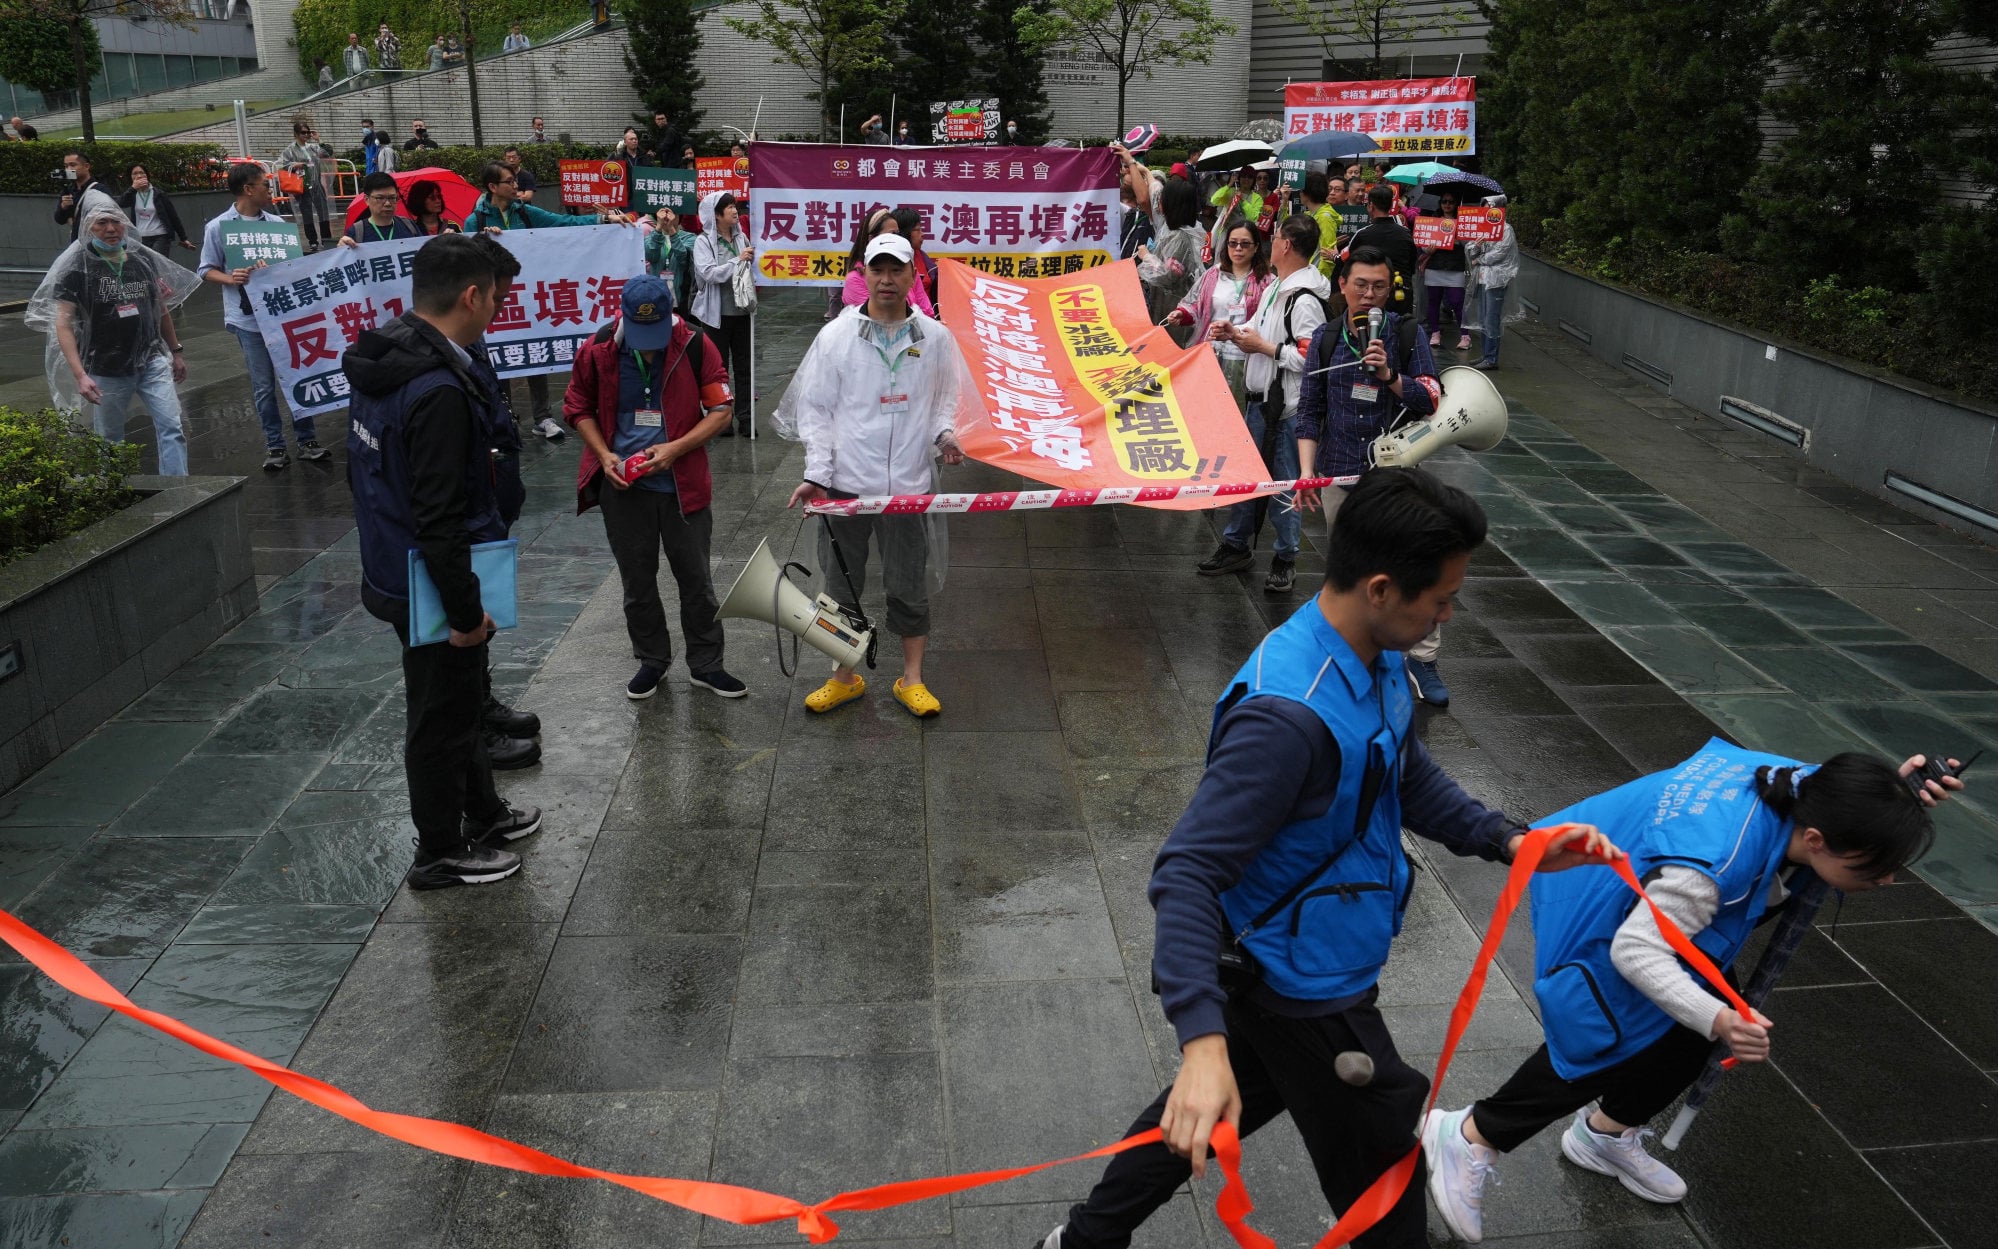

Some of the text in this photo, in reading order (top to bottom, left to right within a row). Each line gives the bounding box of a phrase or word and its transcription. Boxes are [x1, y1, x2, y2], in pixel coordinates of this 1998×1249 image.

[1082, 63, 1100, 71] LENG
[1102, 64, 1120, 72] PUBLI
[1289, 108, 1469, 135] 反對將軍澳再填海
[1376, 138, 1466, 152] 要垃圾處理廠!!
[857, 158, 1050, 180] 都會駅業主委員會
[563, 172, 599, 182] 反對興建
[564, 183, 591, 192] 水泥廠
[634, 178, 695, 193] 反對將軍澳
[647, 194, 684, 207] 再填海
[226, 232, 299, 247] 反對將軍澳
[242, 247, 287, 260] 再填海
[937, 254, 1106, 279] 垃圾處理廠!!
[262, 250, 419, 317] 維景灣畔居民
[486, 275, 630, 334] 區填海
[1666, 782, 1696, 819] MEDIA
